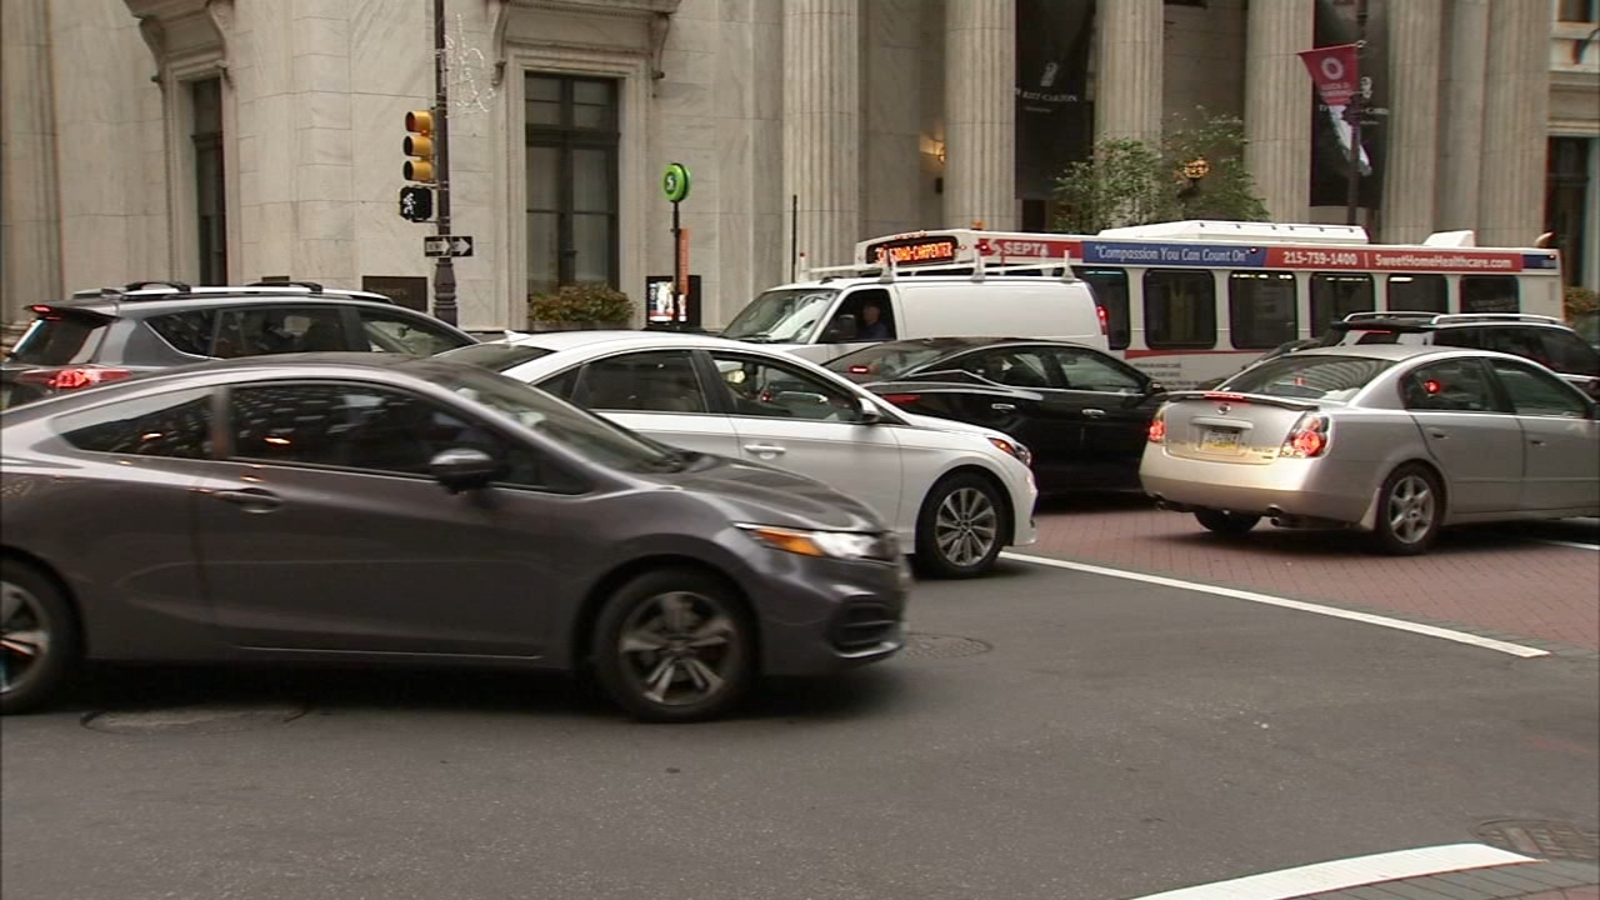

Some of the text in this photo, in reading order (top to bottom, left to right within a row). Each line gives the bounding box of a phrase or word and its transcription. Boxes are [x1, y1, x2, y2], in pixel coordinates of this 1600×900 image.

[1004, 242, 1049, 256] SEPTA
[1160, 247, 1178, 260] You
[1181, 249, 1201, 261] Can
[1202, 249, 1231, 261] Count
[1375, 253, 1512, 269] SweetHomeHealthcare.com
